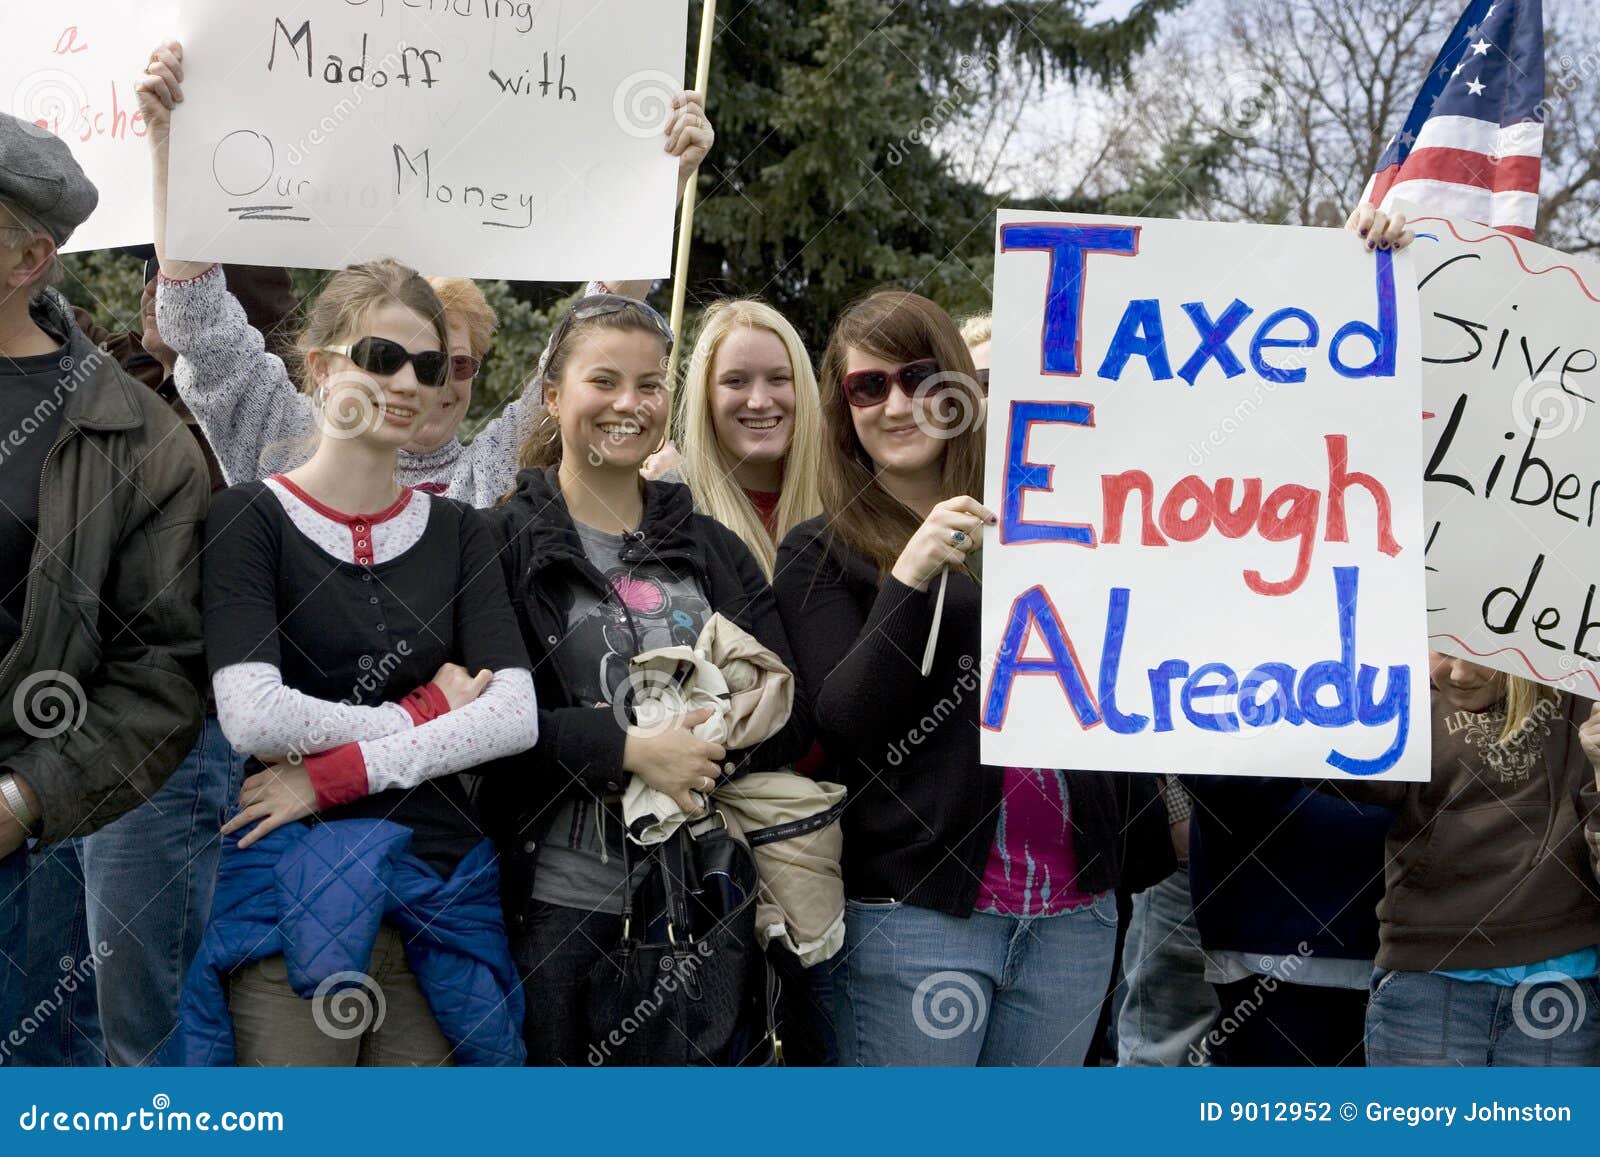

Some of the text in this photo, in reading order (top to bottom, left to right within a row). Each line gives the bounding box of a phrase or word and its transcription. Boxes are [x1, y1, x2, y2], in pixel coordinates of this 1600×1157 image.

[53, 26, 89, 55] a
[267, 17, 577, 101] Madoff with
[344, 0, 533, 33] nding
[212, 129, 534, 229] Our Money
[1000, 222, 1398, 386] Taxed
[1417, 253, 1598, 404] Give
[999, 400, 1403, 597] Enough
[980, 565, 1410, 776] Already
[1444, 710, 1491, 736] LIVE
